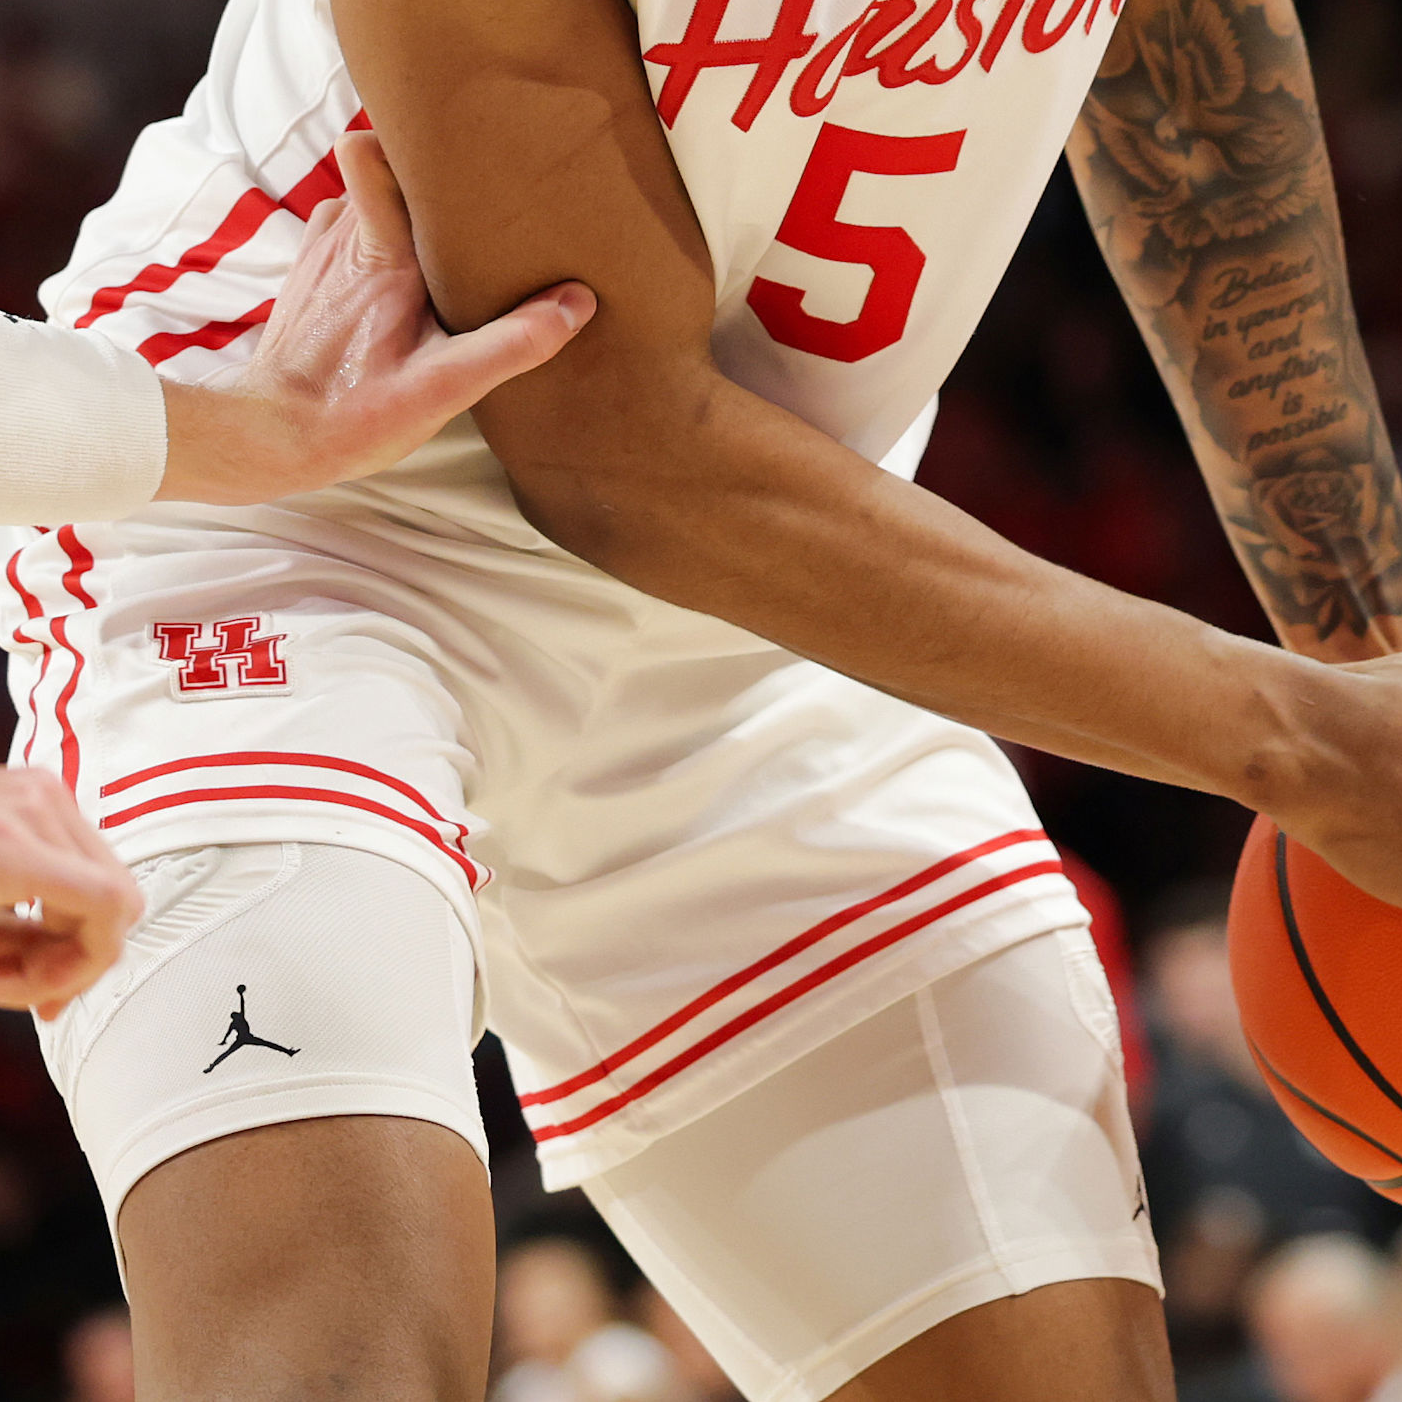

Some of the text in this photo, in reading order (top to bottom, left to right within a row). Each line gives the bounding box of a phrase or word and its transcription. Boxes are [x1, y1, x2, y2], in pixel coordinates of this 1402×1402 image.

[746, 121, 968, 365] 5
[1203, 314, 1228, 341] in
[1248, 319, 1302, 360] and
